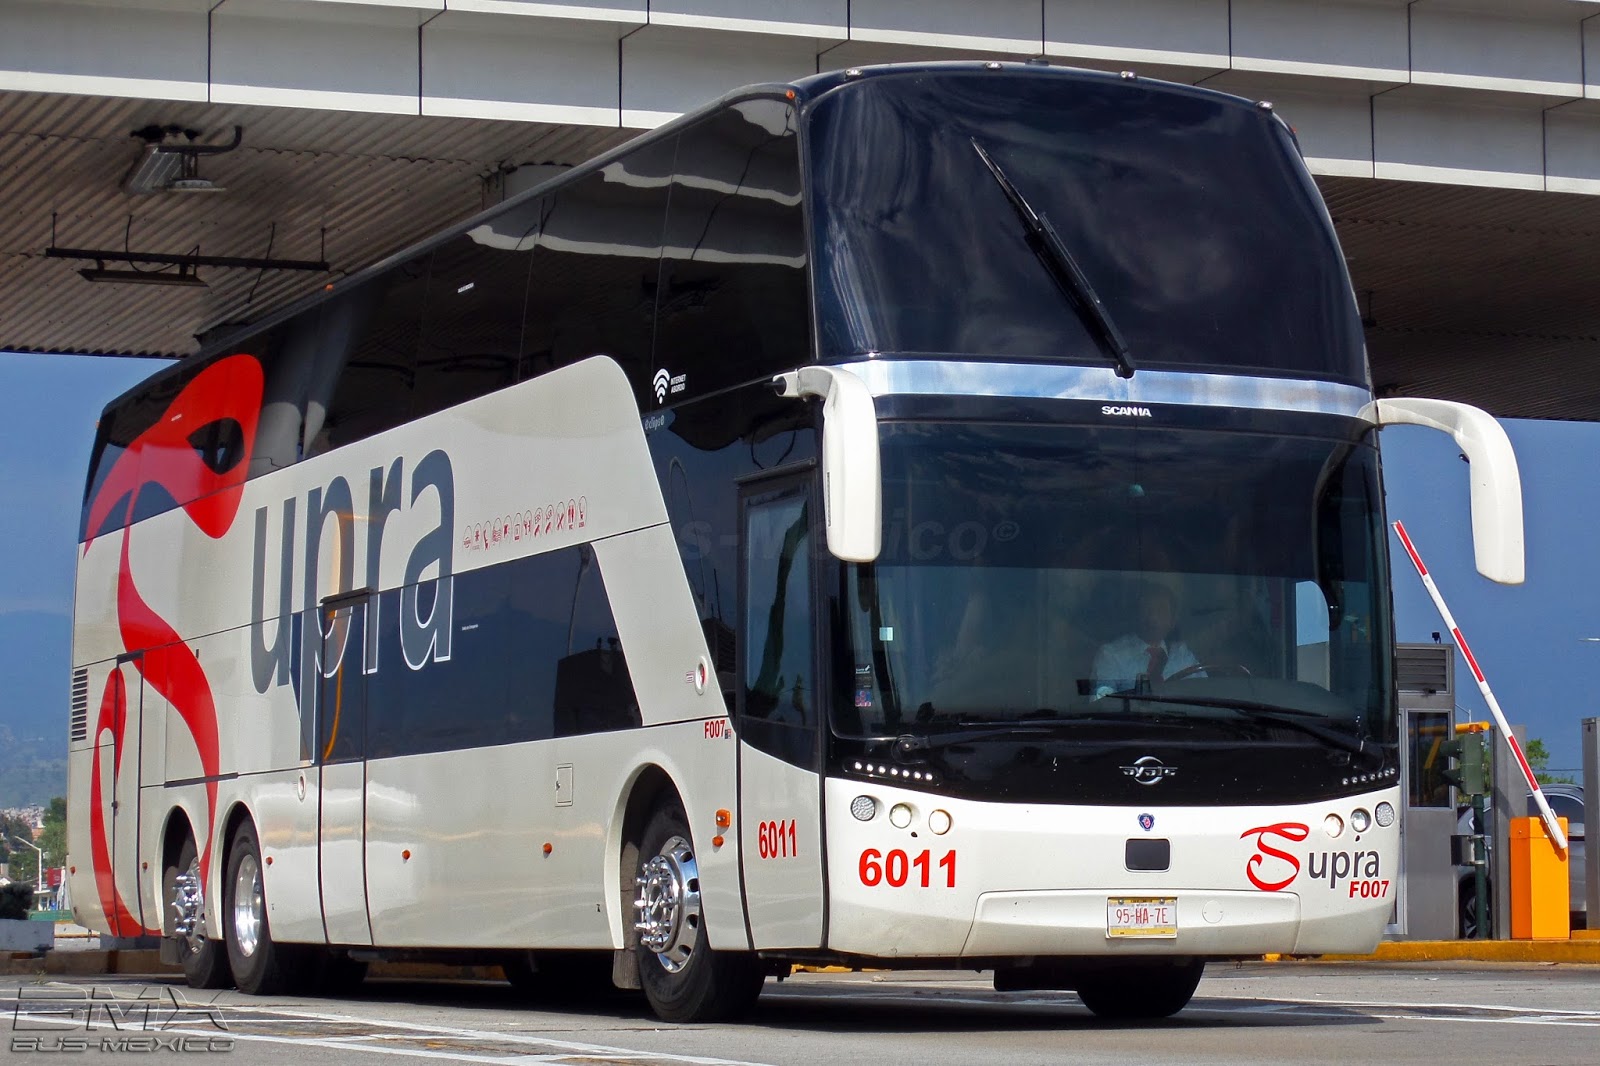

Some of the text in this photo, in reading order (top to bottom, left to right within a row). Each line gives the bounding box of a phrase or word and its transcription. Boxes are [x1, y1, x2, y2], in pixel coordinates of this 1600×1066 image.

[1101, 405, 1152, 417] SCANIA
[83, 353, 454, 937] Supra
[704, 719, 726, 739] F007
[758, 819, 797, 859] 6011
[859, 848, 957, 888] 6011
[1240, 822, 1380, 891] Supra
[1349, 880, 1390, 898] F007
[1115, 907, 1169, 925] 95-HA-7E
